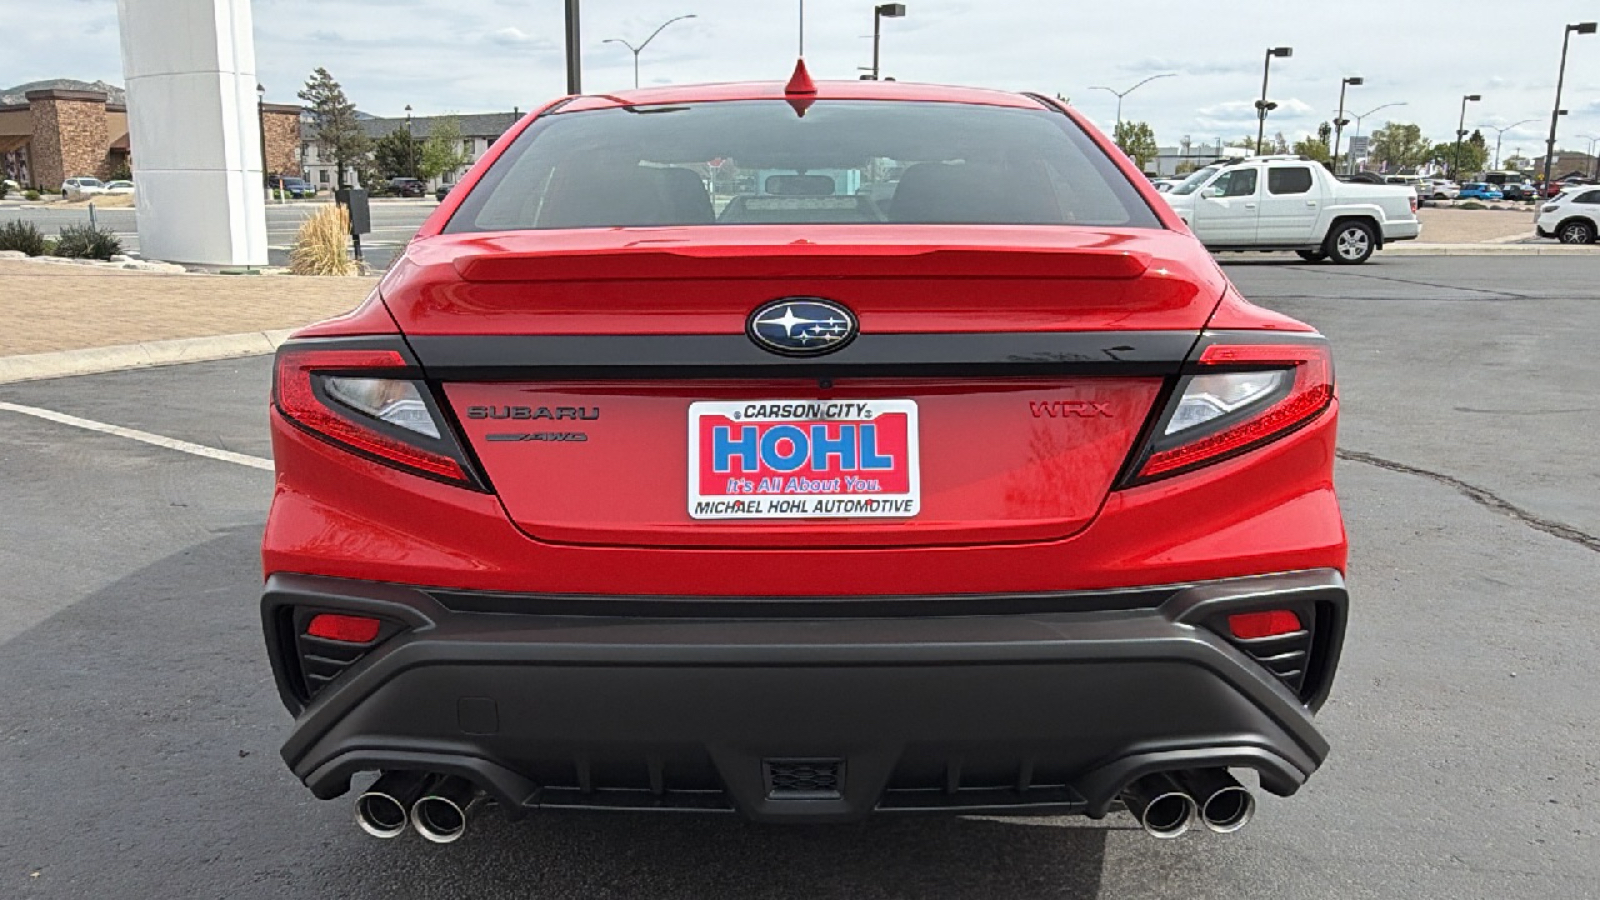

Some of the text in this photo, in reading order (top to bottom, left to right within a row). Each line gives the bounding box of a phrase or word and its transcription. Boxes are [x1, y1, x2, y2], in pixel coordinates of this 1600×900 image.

[467, 405, 600, 420] SUBARU
[744, 403, 869, 419] CARSON CITY
[1029, 401, 1114, 418] WRX
[713, 424, 894, 472] HOHL
[727, 475, 882, 493] It's All About You.
[695, 499, 914, 514] MICHAEL HOHL AUTOMOTIVE
